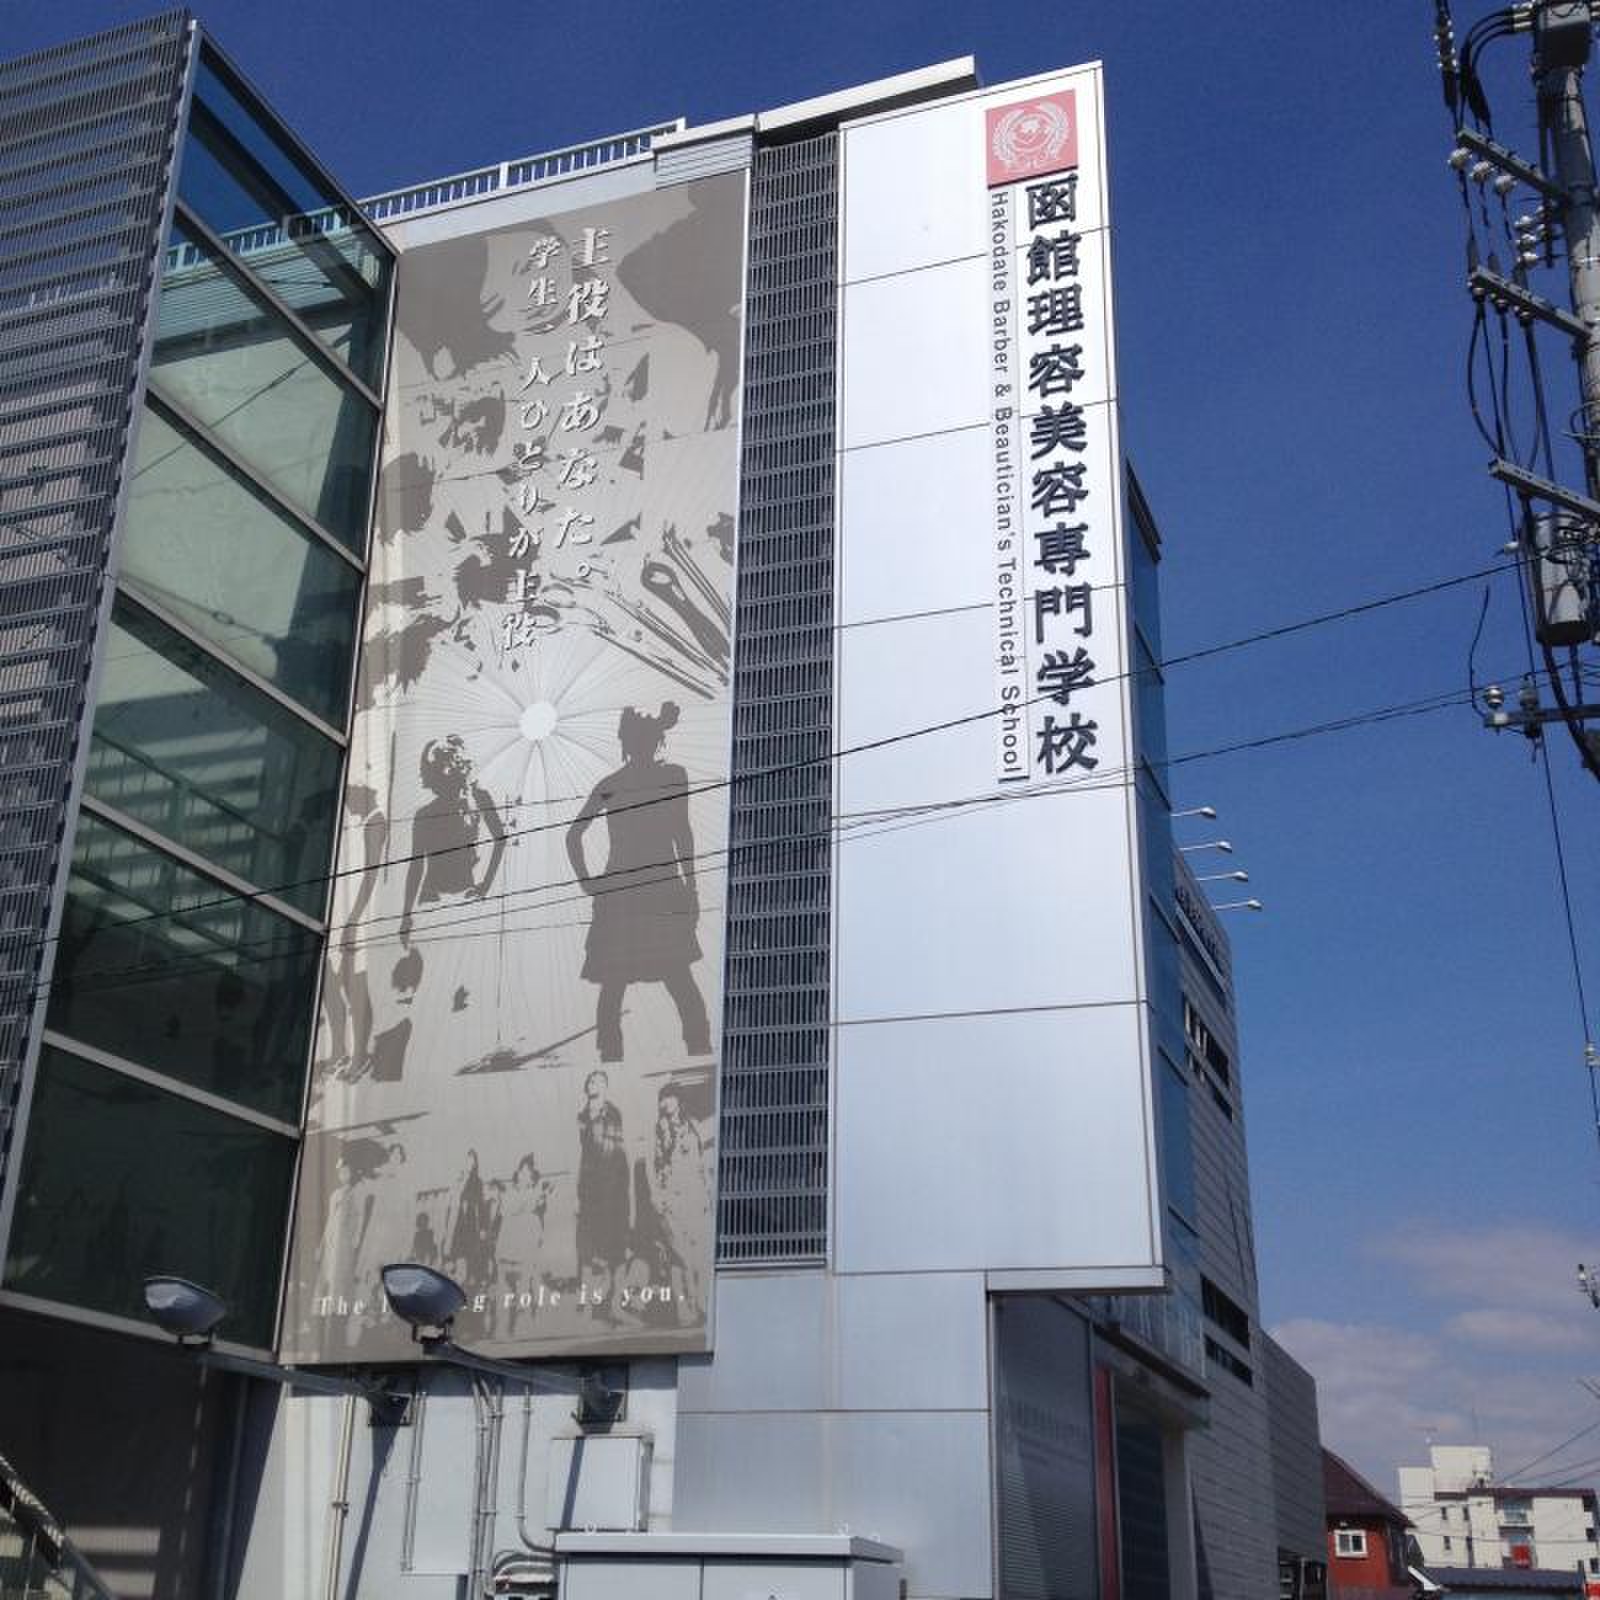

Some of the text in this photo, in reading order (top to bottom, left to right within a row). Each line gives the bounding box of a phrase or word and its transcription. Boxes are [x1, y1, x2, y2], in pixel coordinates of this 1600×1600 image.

[991, 191, 1022, 774] Hakodate Barber & Beautician's Technical School
[1025, 173, 1099, 774] 函館理容美容専門学校
[319, 1294, 367, 1317] The
[503, 1287, 561, 1308] role
[580, 1283, 604, 1305] is
